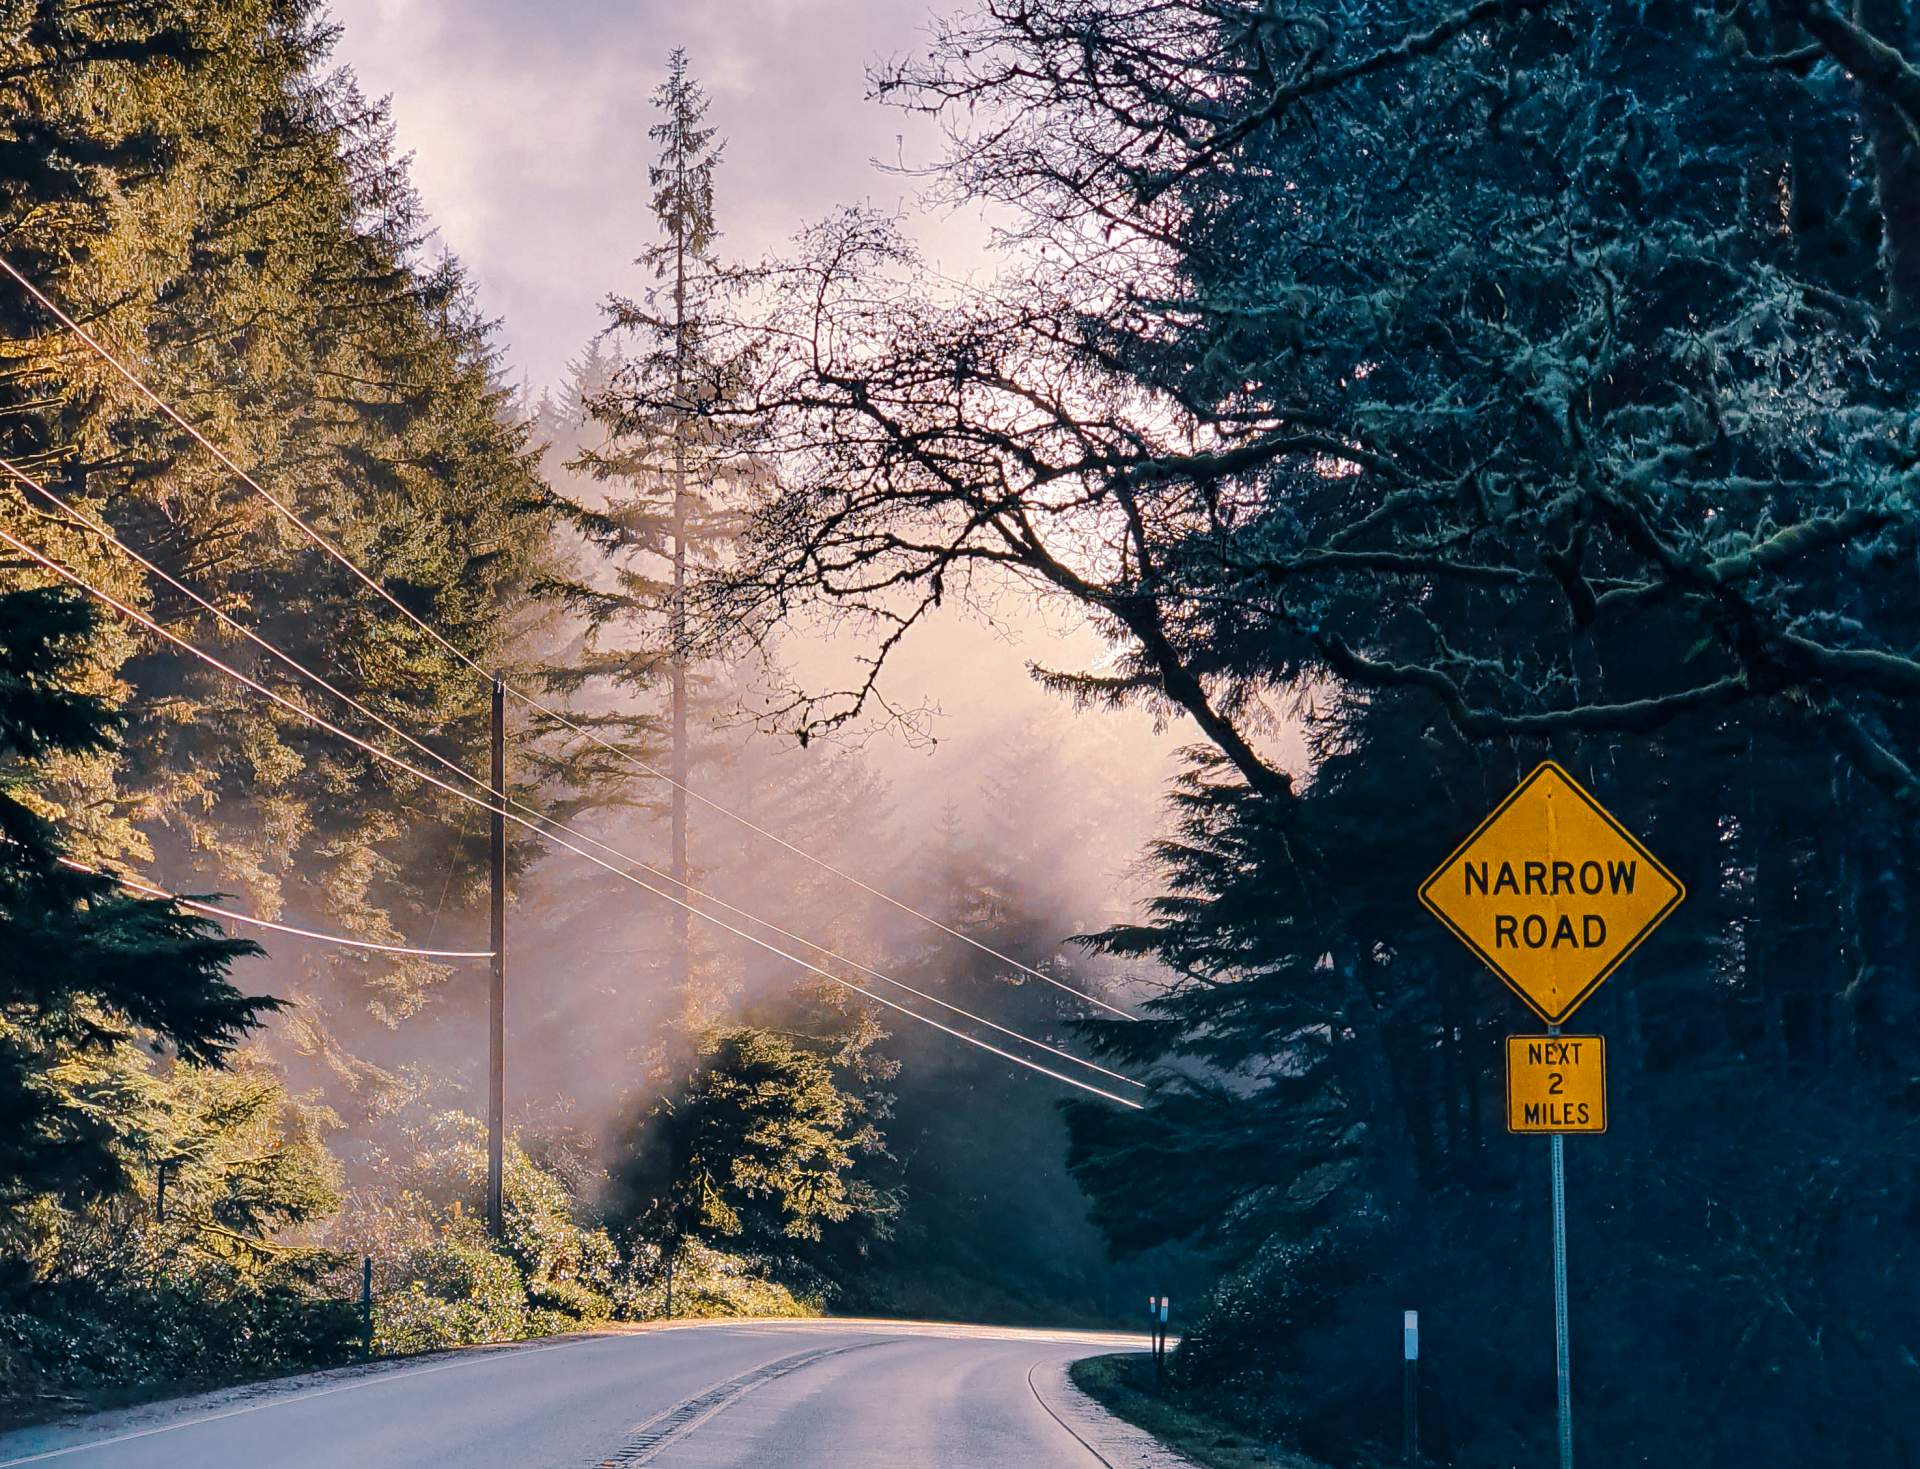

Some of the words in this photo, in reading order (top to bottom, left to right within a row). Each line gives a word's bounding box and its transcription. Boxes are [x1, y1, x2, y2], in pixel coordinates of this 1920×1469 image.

[1464, 861, 1637, 896] NARROW
[1495, 914, 1607, 949] ROAD
[1528, 1043, 1583, 1065] NEXT
[1548, 1073, 1564, 1095] 2
[1524, 1103, 1589, 1125] MILES
